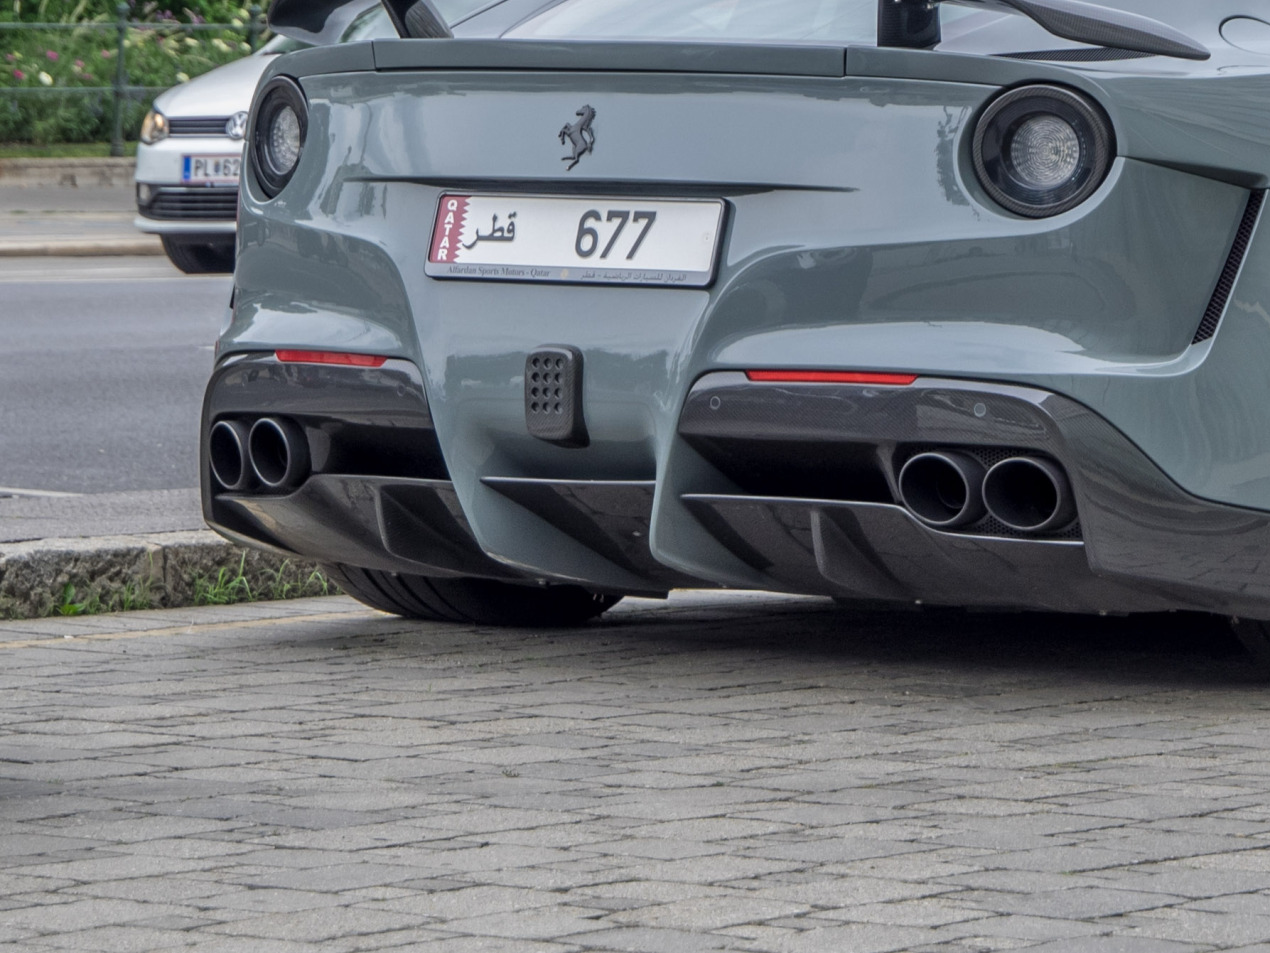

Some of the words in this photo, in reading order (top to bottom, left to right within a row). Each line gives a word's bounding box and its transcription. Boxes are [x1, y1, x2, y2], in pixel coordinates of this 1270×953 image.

[194, 159, 210, 177] PL
[437, 199, 458, 261] QATAR
[462, 211, 517, 250] قطر
[575, 209, 657, 260] 677
[478, 266, 499, 277] Sports
[501, 267, 525, 277] Motors
[530, 268, 550, 278] Qatar
